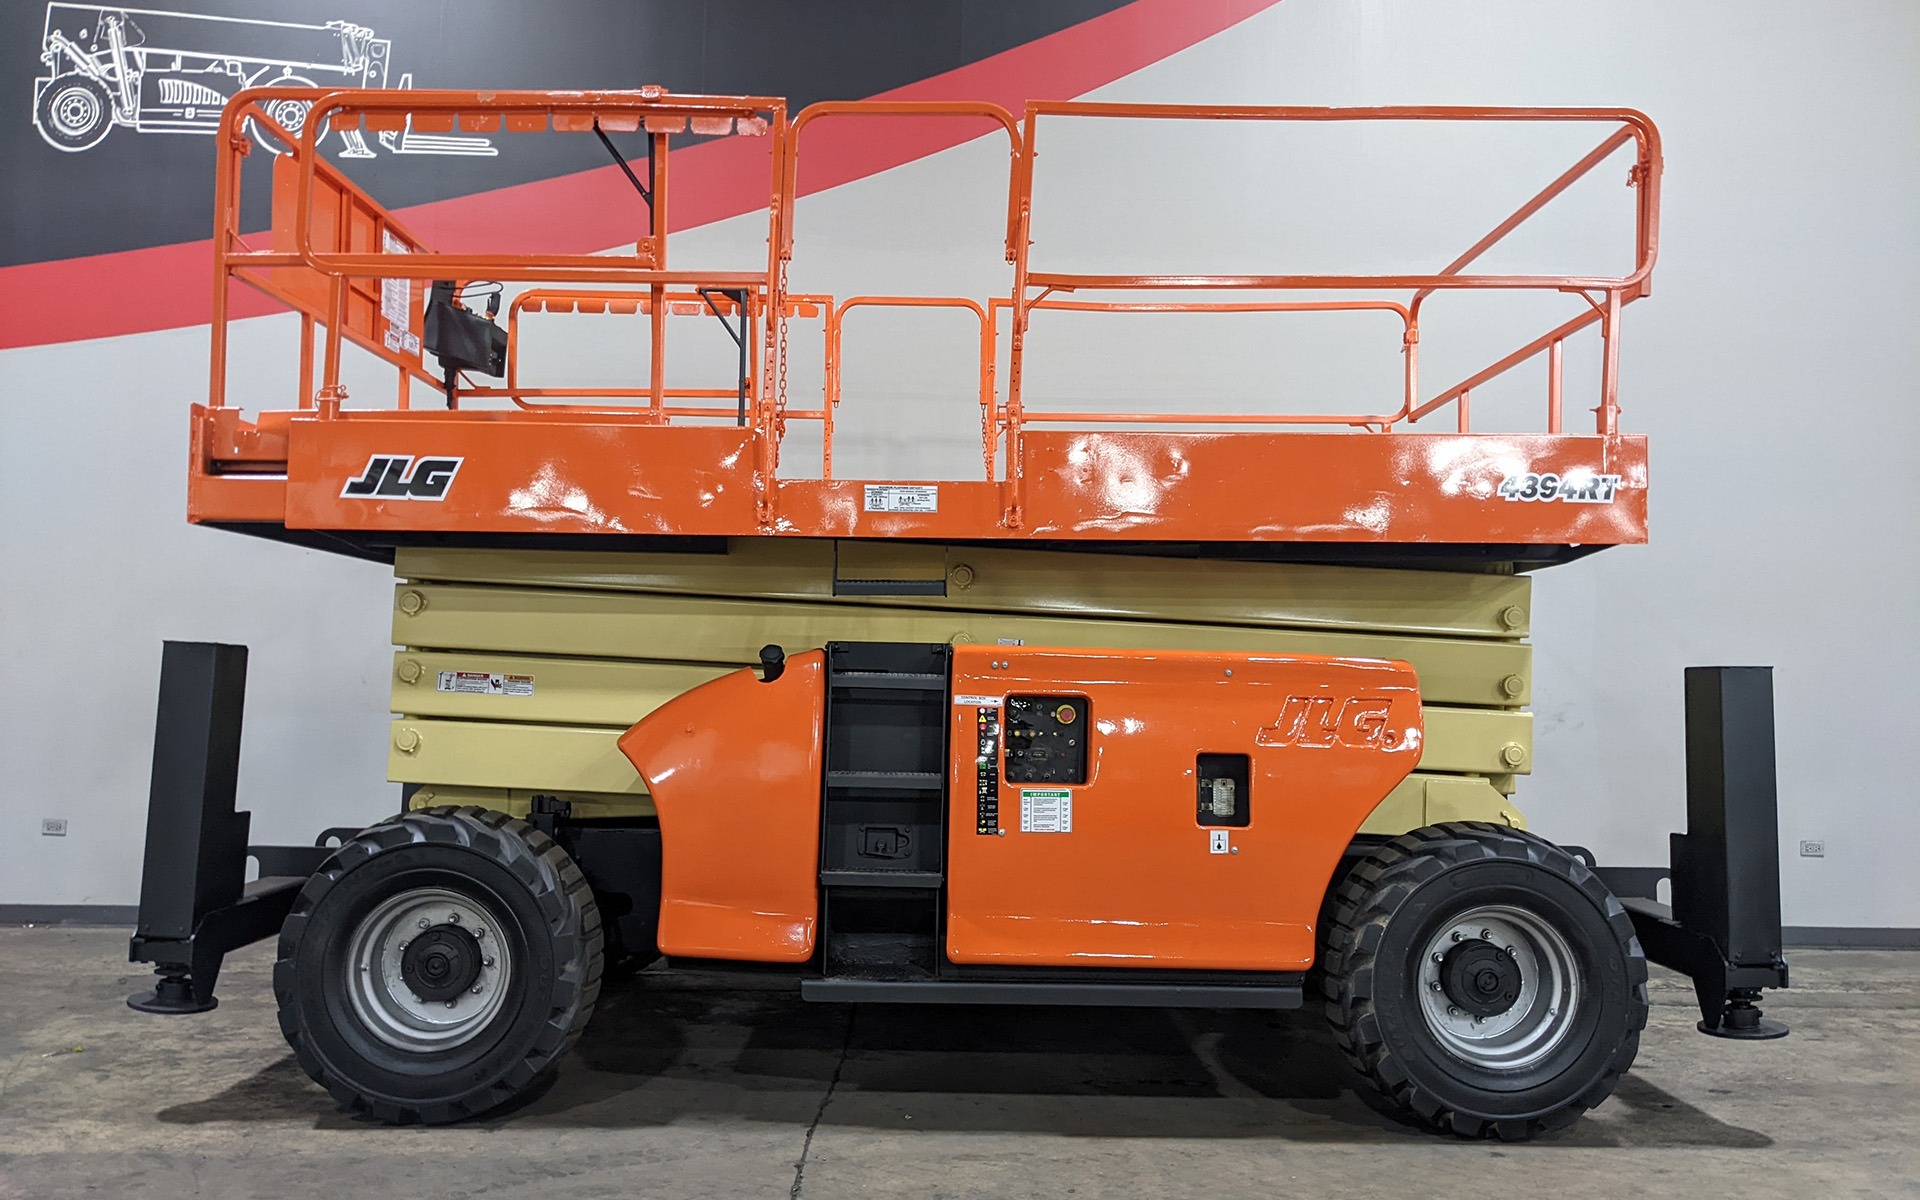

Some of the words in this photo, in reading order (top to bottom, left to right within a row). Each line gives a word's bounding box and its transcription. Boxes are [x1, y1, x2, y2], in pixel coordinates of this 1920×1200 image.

[341, 455, 463, 500] JLG
[1498, 474, 1620, 502] 4394RT
[1255, 695, 1393, 748] JLG
